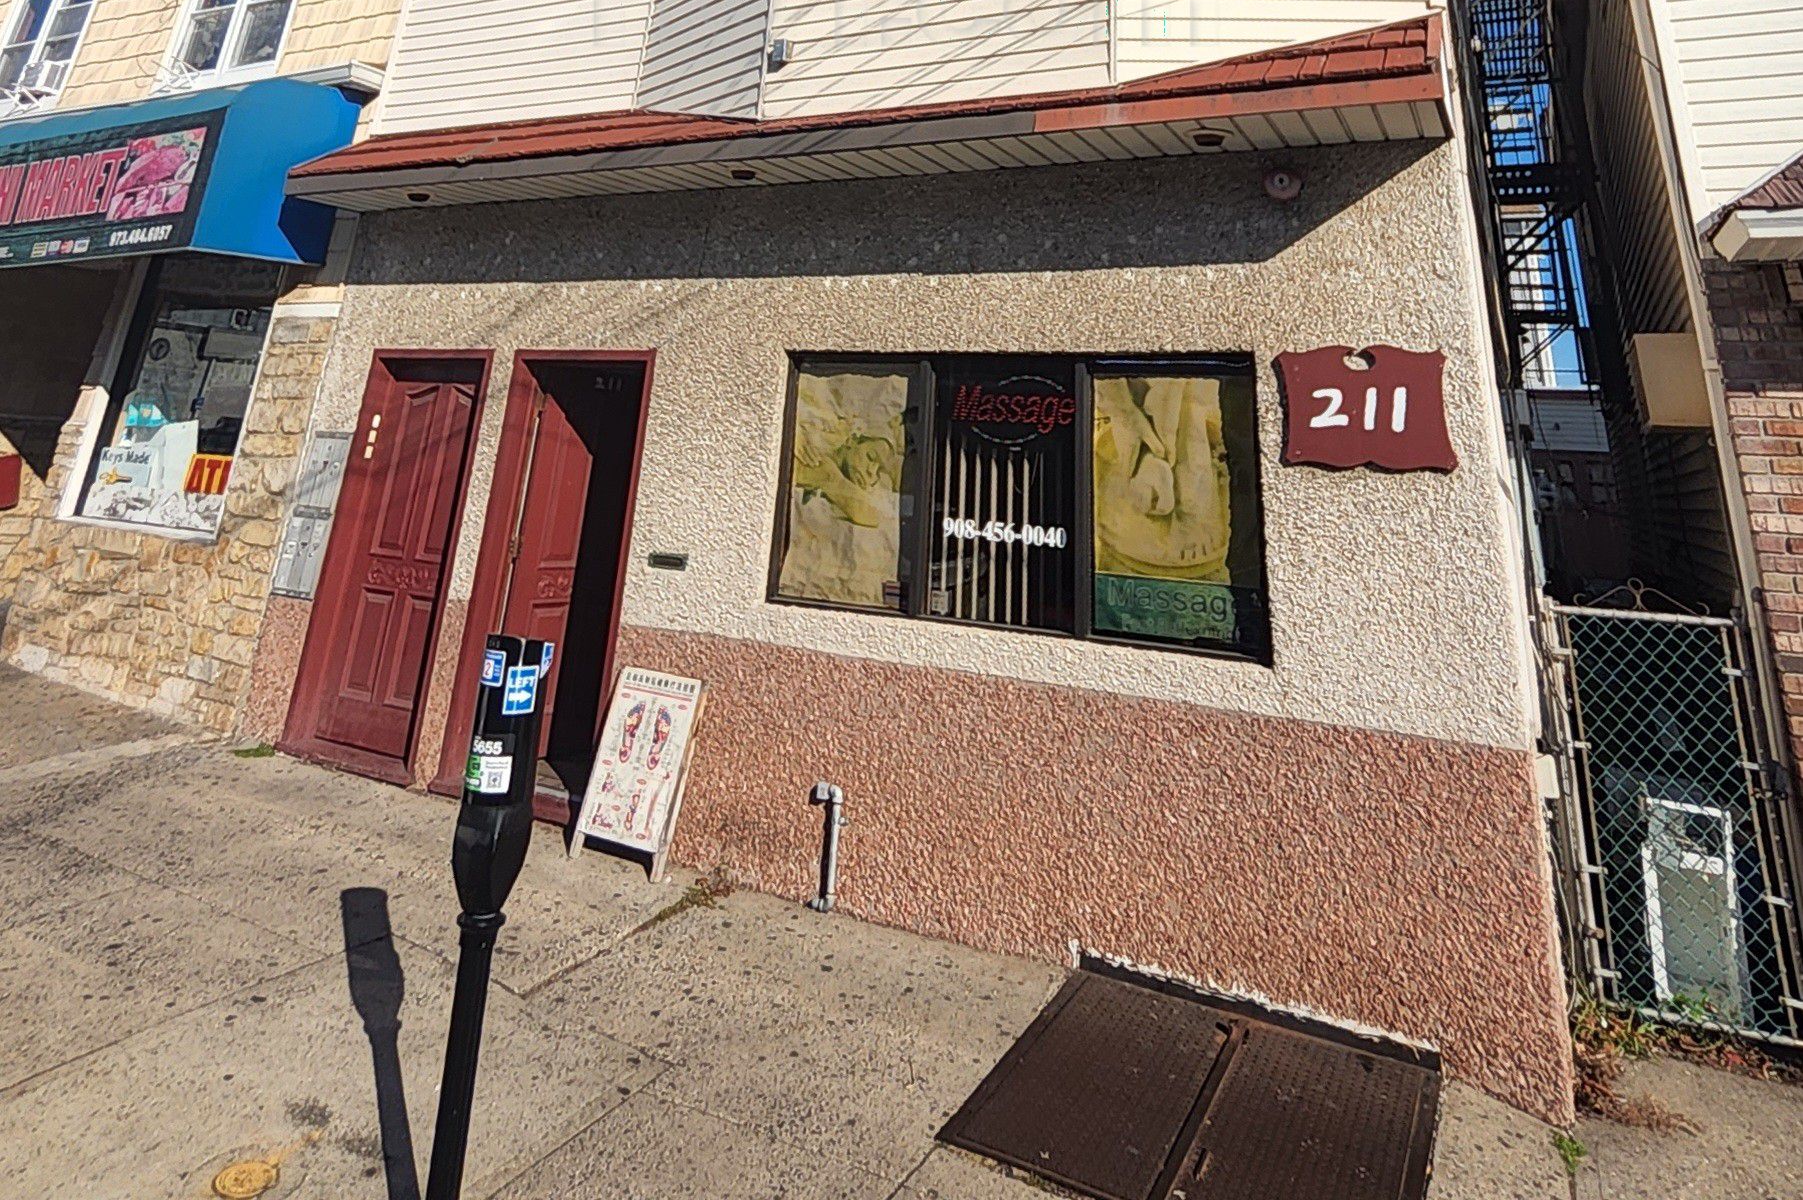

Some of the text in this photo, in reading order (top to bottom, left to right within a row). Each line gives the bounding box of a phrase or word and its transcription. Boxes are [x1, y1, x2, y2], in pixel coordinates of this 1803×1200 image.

[13, 146, 129, 224] MARKET
[951, 384, 1076, 434] Massage
[1309, 386, 1407, 433] 211
[943, 517, 1067, 548] 908-456-0040
[508, 675, 536, 689] LEFT
